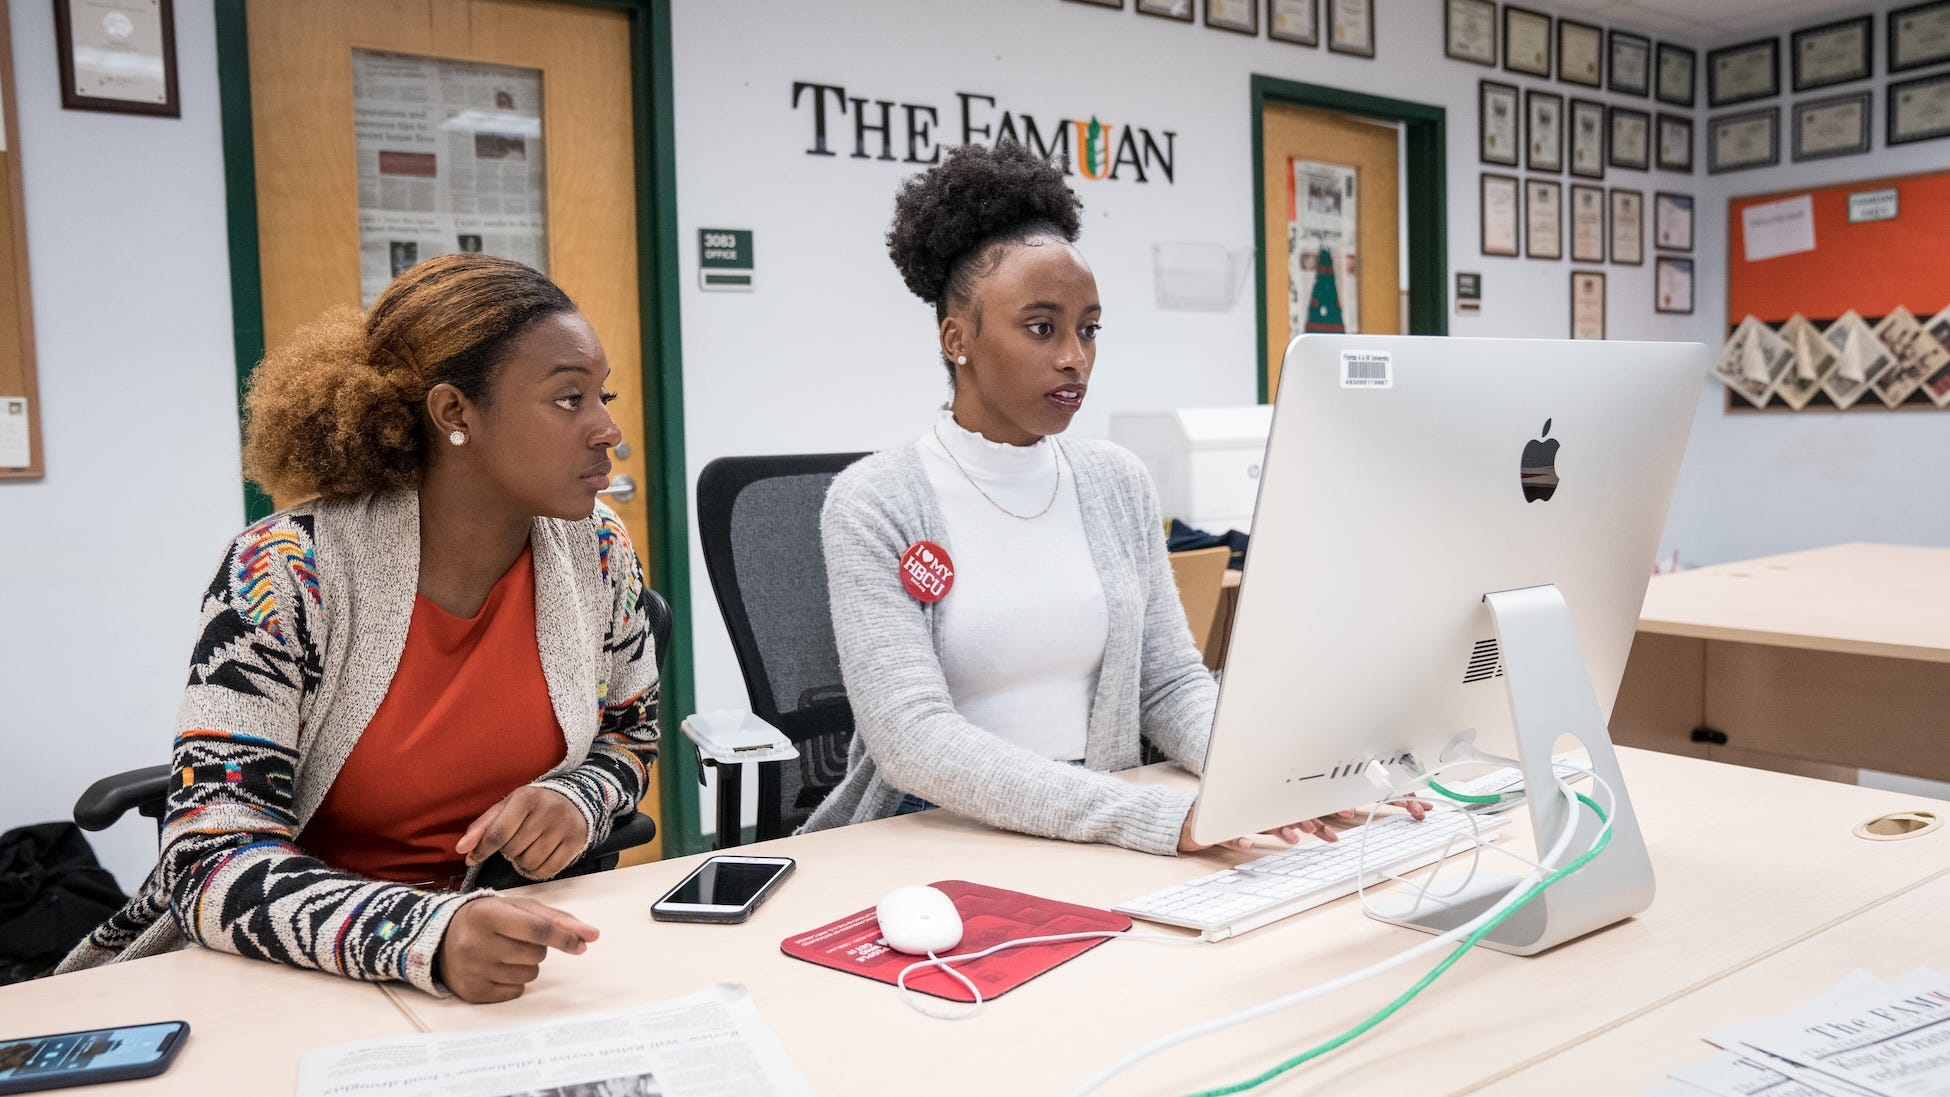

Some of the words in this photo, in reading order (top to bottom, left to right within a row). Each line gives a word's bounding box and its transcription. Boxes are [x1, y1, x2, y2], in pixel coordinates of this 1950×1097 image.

[792, 81, 941, 165] THE
[704, 233, 737, 249] 3083
[704, 250, 738, 260] OFFICE
[903, 555, 946, 596] HBCU
[915, 544, 925, 557] I
[929, 557, 954, 581] MY
[1805, 1018, 1867, 1040] The
